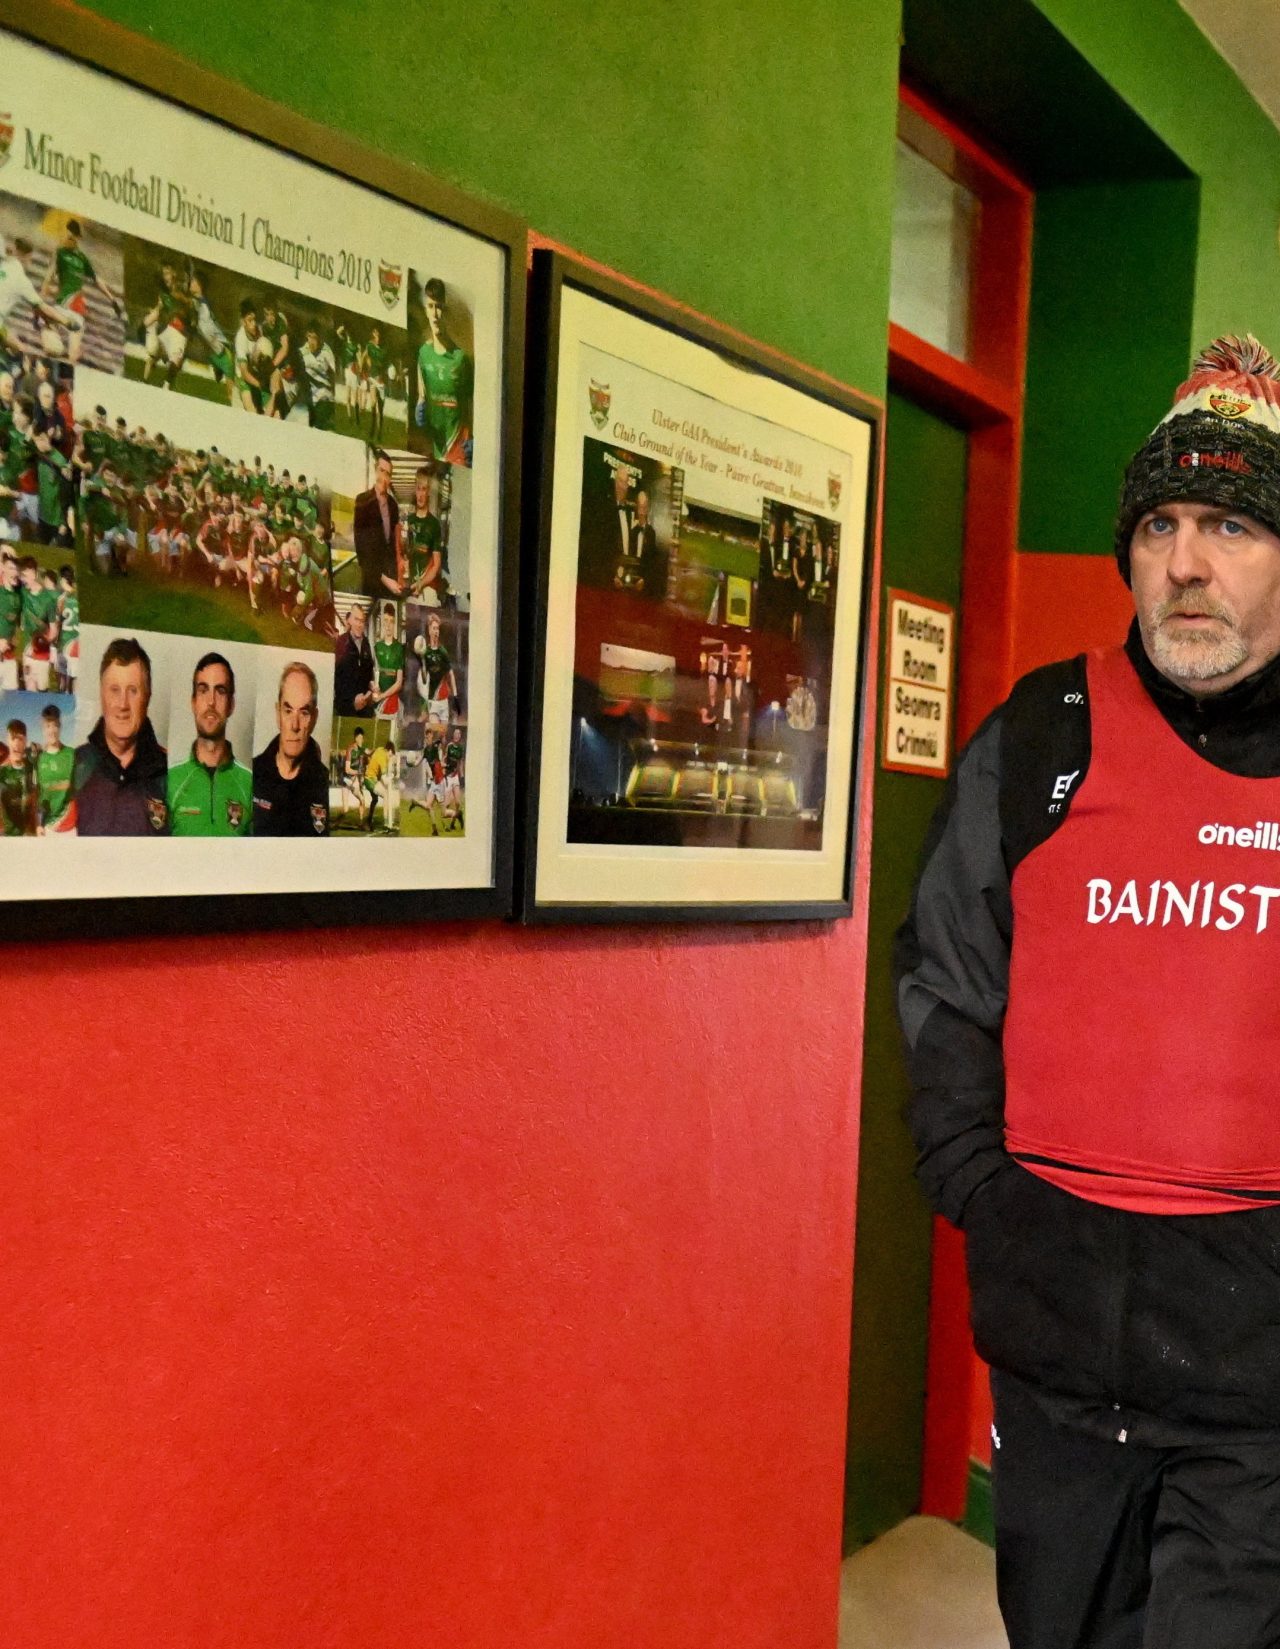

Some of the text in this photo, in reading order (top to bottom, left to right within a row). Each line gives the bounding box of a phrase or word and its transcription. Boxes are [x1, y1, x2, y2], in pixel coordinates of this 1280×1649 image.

[24, 127, 372, 294] Minor Football Division 1 Champions 2018
[613, 422, 636, 444] Club
[639, 432, 674, 457] Ground
[675, 447, 686, 465] of
[685, 450, 698, 464] the
[652, 408, 680, 432] Ulster
[681, 420, 700, 441] GAA
[897, 608, 944, 653] Meeting
[903, 649, 937, 682] Room
[895, 686, 941, 721] Seomra
